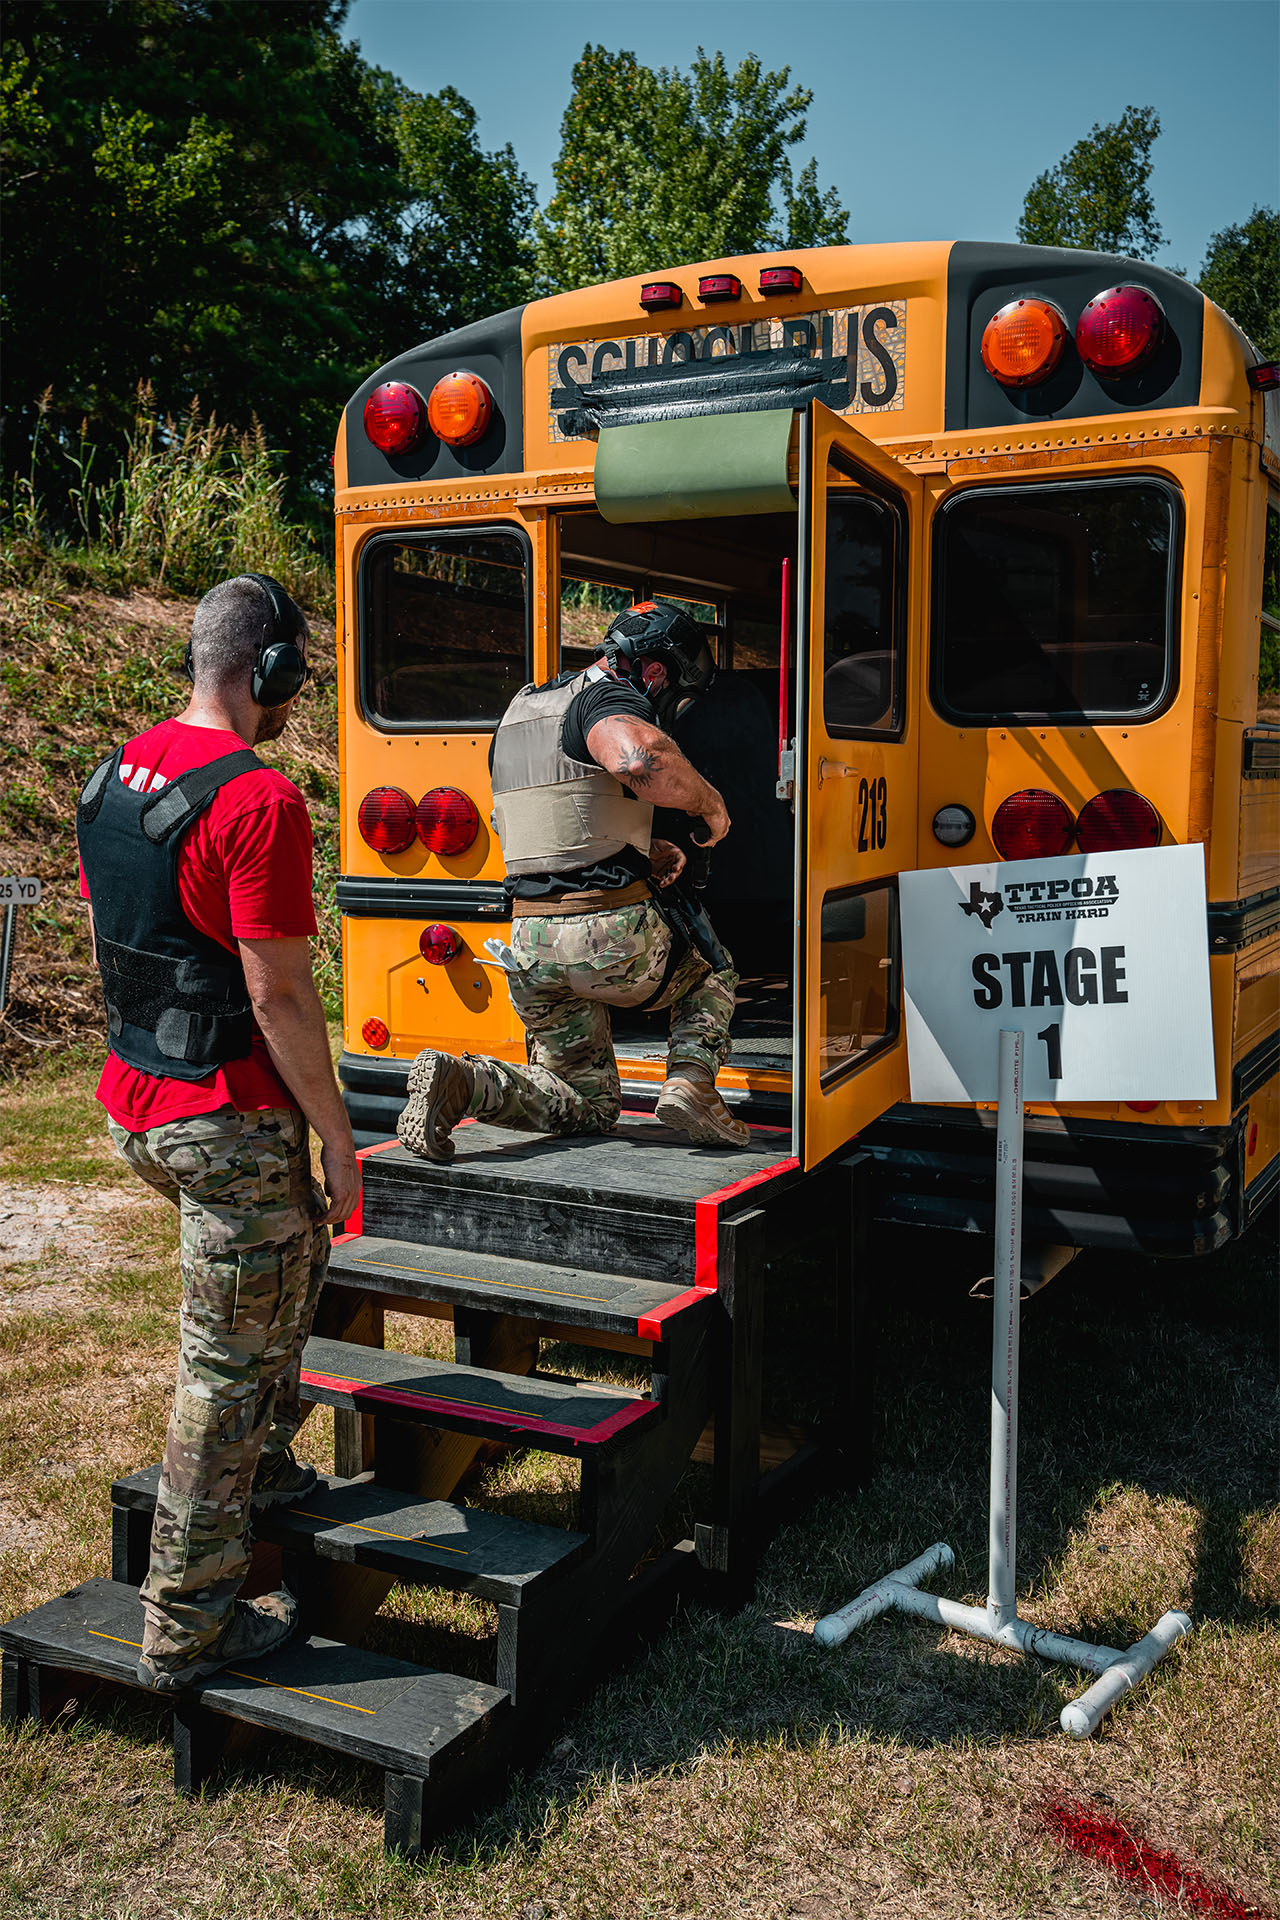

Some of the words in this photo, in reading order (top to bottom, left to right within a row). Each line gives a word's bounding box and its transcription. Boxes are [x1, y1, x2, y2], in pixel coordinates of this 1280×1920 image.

[857, 776, 887, 853] 213
[0, 883, 13, 898] 25
[18, 883, 37, 898] YD
[1004, 875, 1119, 903] TTPOA
[1016, 911, 1062, 923] TRAIN
[1065, 907, 1109, 920] HARD
[971, 945, 1129, 1010] STAGE
[1037, 1023, 1063, 1079] 1
